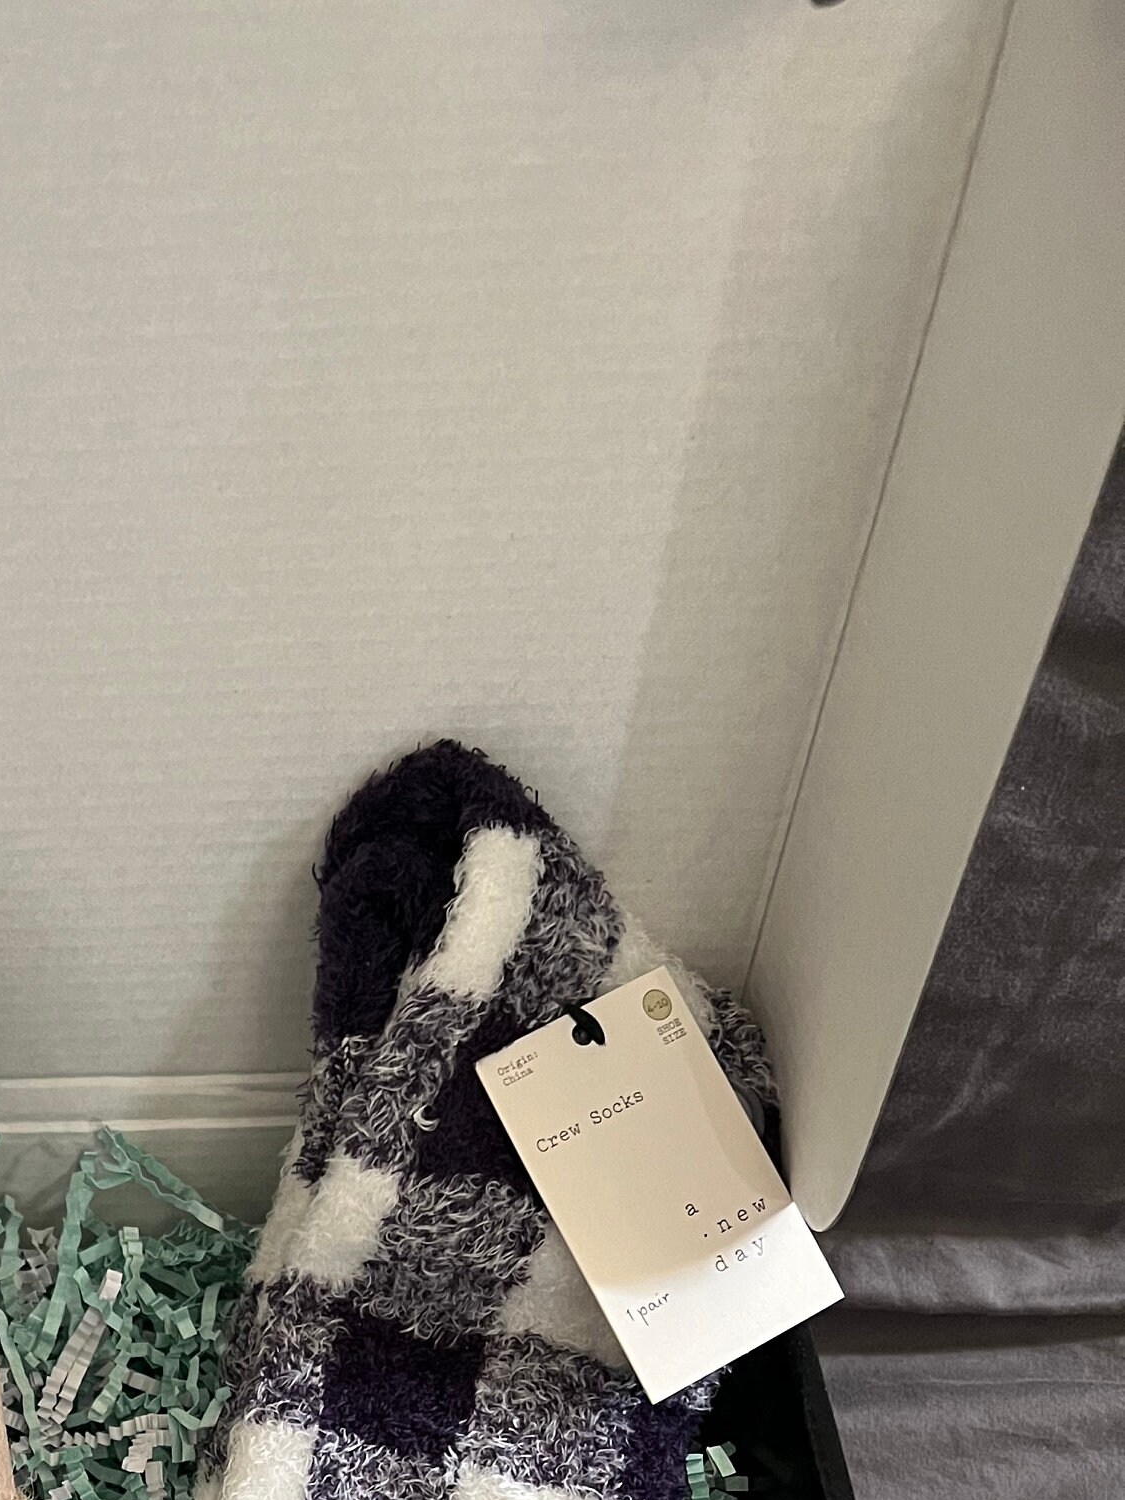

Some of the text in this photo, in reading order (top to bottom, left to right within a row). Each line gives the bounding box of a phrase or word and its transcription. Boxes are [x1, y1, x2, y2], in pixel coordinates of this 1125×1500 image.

[656, 1018, 682, 1036] SHOE
[662, 1028, 687, 1045] SIZE
[497, 1051, 539, 1076] Origin:
[502, 1067, 534, 1086] China
[536, 1090, 644, 1153] Crew Socks
[684, 1203, 700, 1217] a
[714, 1235, 768, 1273] day
[637, 1292, 670, 1327] pair
